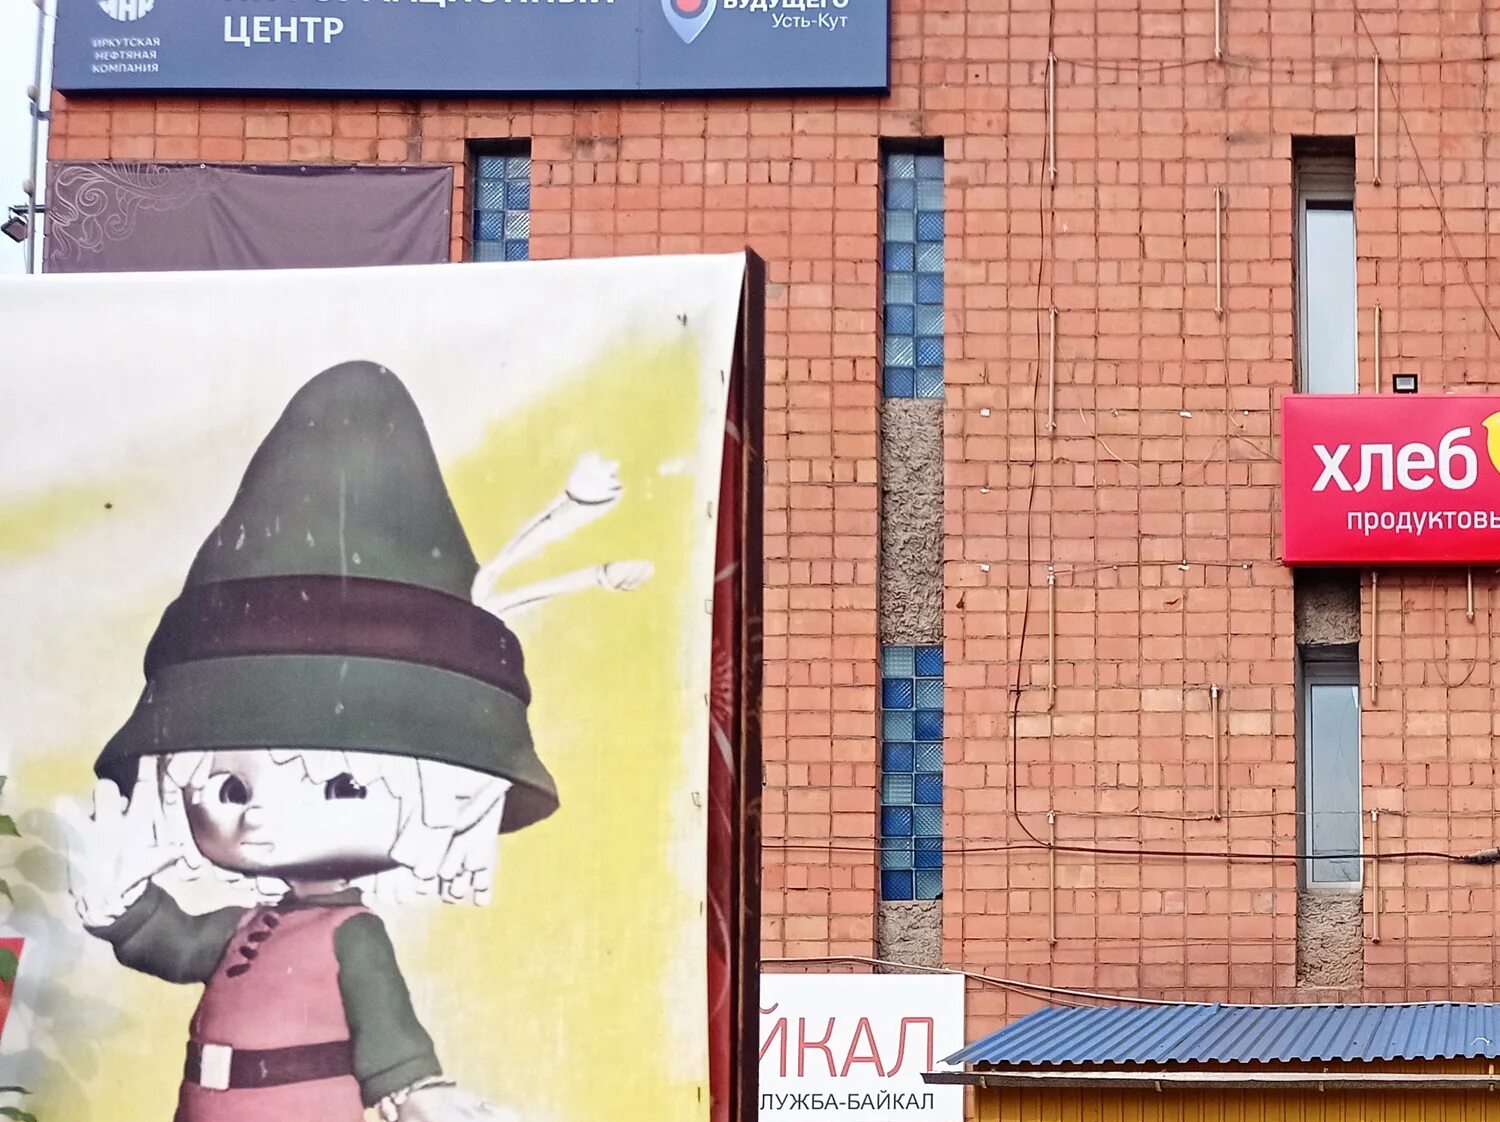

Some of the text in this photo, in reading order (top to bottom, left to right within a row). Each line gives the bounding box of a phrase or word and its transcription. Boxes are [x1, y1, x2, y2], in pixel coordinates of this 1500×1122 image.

[771, 13, 848, 31] Усть-Кут
[223, 15, 345, 47] ЦЕНТР
[92, 37, 160, 47] ИРКУТСКАЯ
[94, 50, 157, 60] НЕФТЯНАЯ
[92, 63, 159, 73] КОМПАНИЯ
[1312, 426, 1478, 492] хлеб
